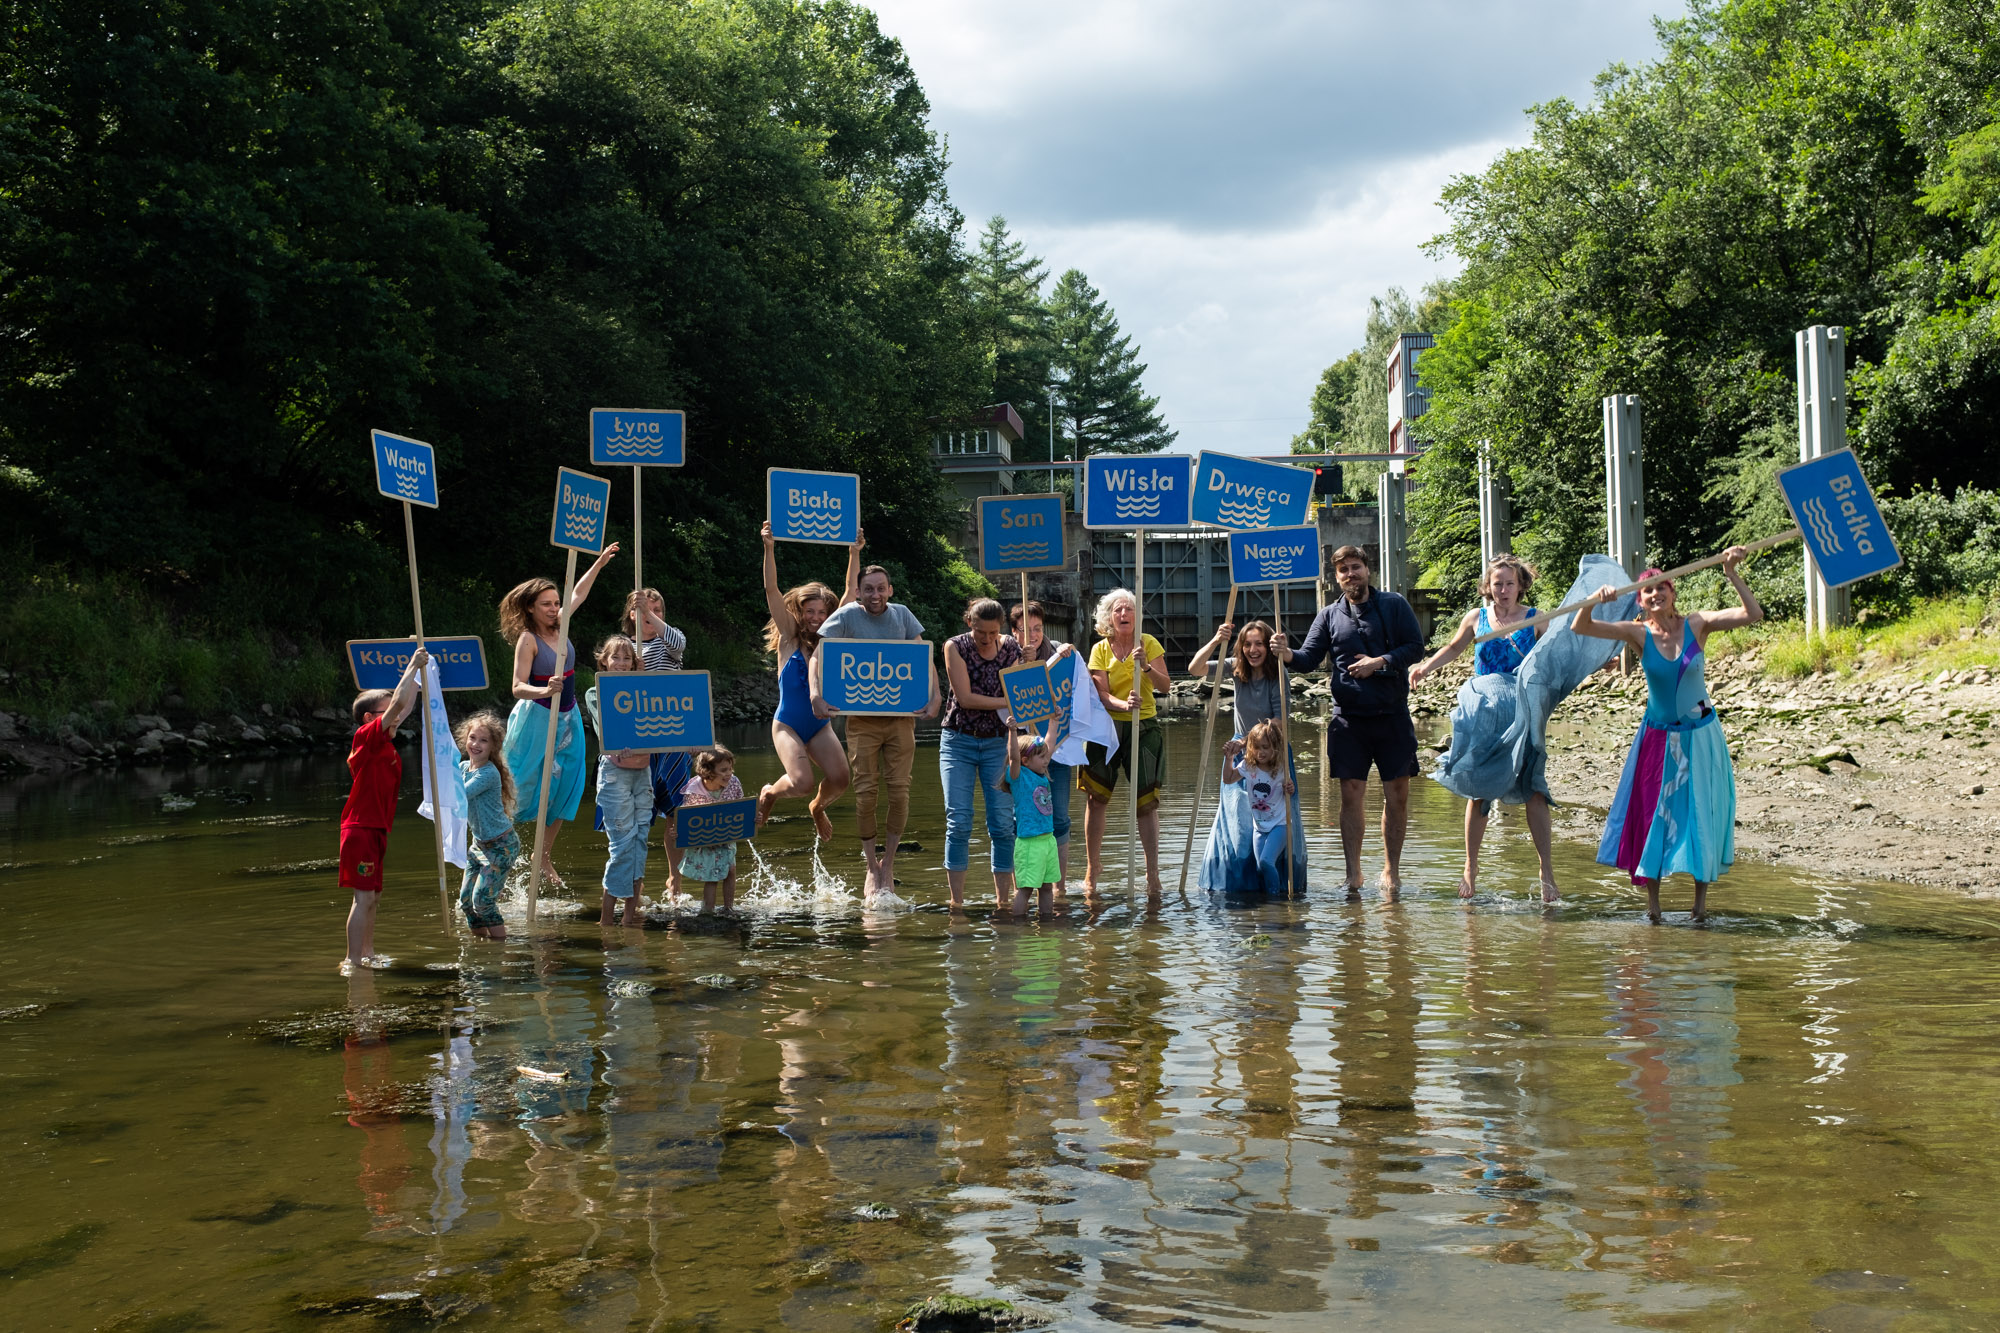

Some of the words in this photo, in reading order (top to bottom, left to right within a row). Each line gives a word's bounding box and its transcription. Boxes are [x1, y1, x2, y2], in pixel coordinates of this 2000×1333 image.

[613, 415, 660, 435] Łyna
[384, 446, 427, 476] Warta
[1103, 468, 1174, 492] Wisła
[1208, 468, 1291, 507] Drwęca
[563, 484, 601, 514] Bystra
[788, 488, 842, 510] Biała
[1000, 507, 1044, 529] San
[1828, 474, 1875, 556] Białka
[1244, 543, 1305, 560] Narew
[360, 648, 472, 668] Kłopnica
[840, 651, 913, 681] Raba
[613, 689, 694, 714] Glinna
[1012, 684, 1045, 701] Sawa
[1053, 677, 1072, 702] ug
[687, 812, 745, 829] Orlica
